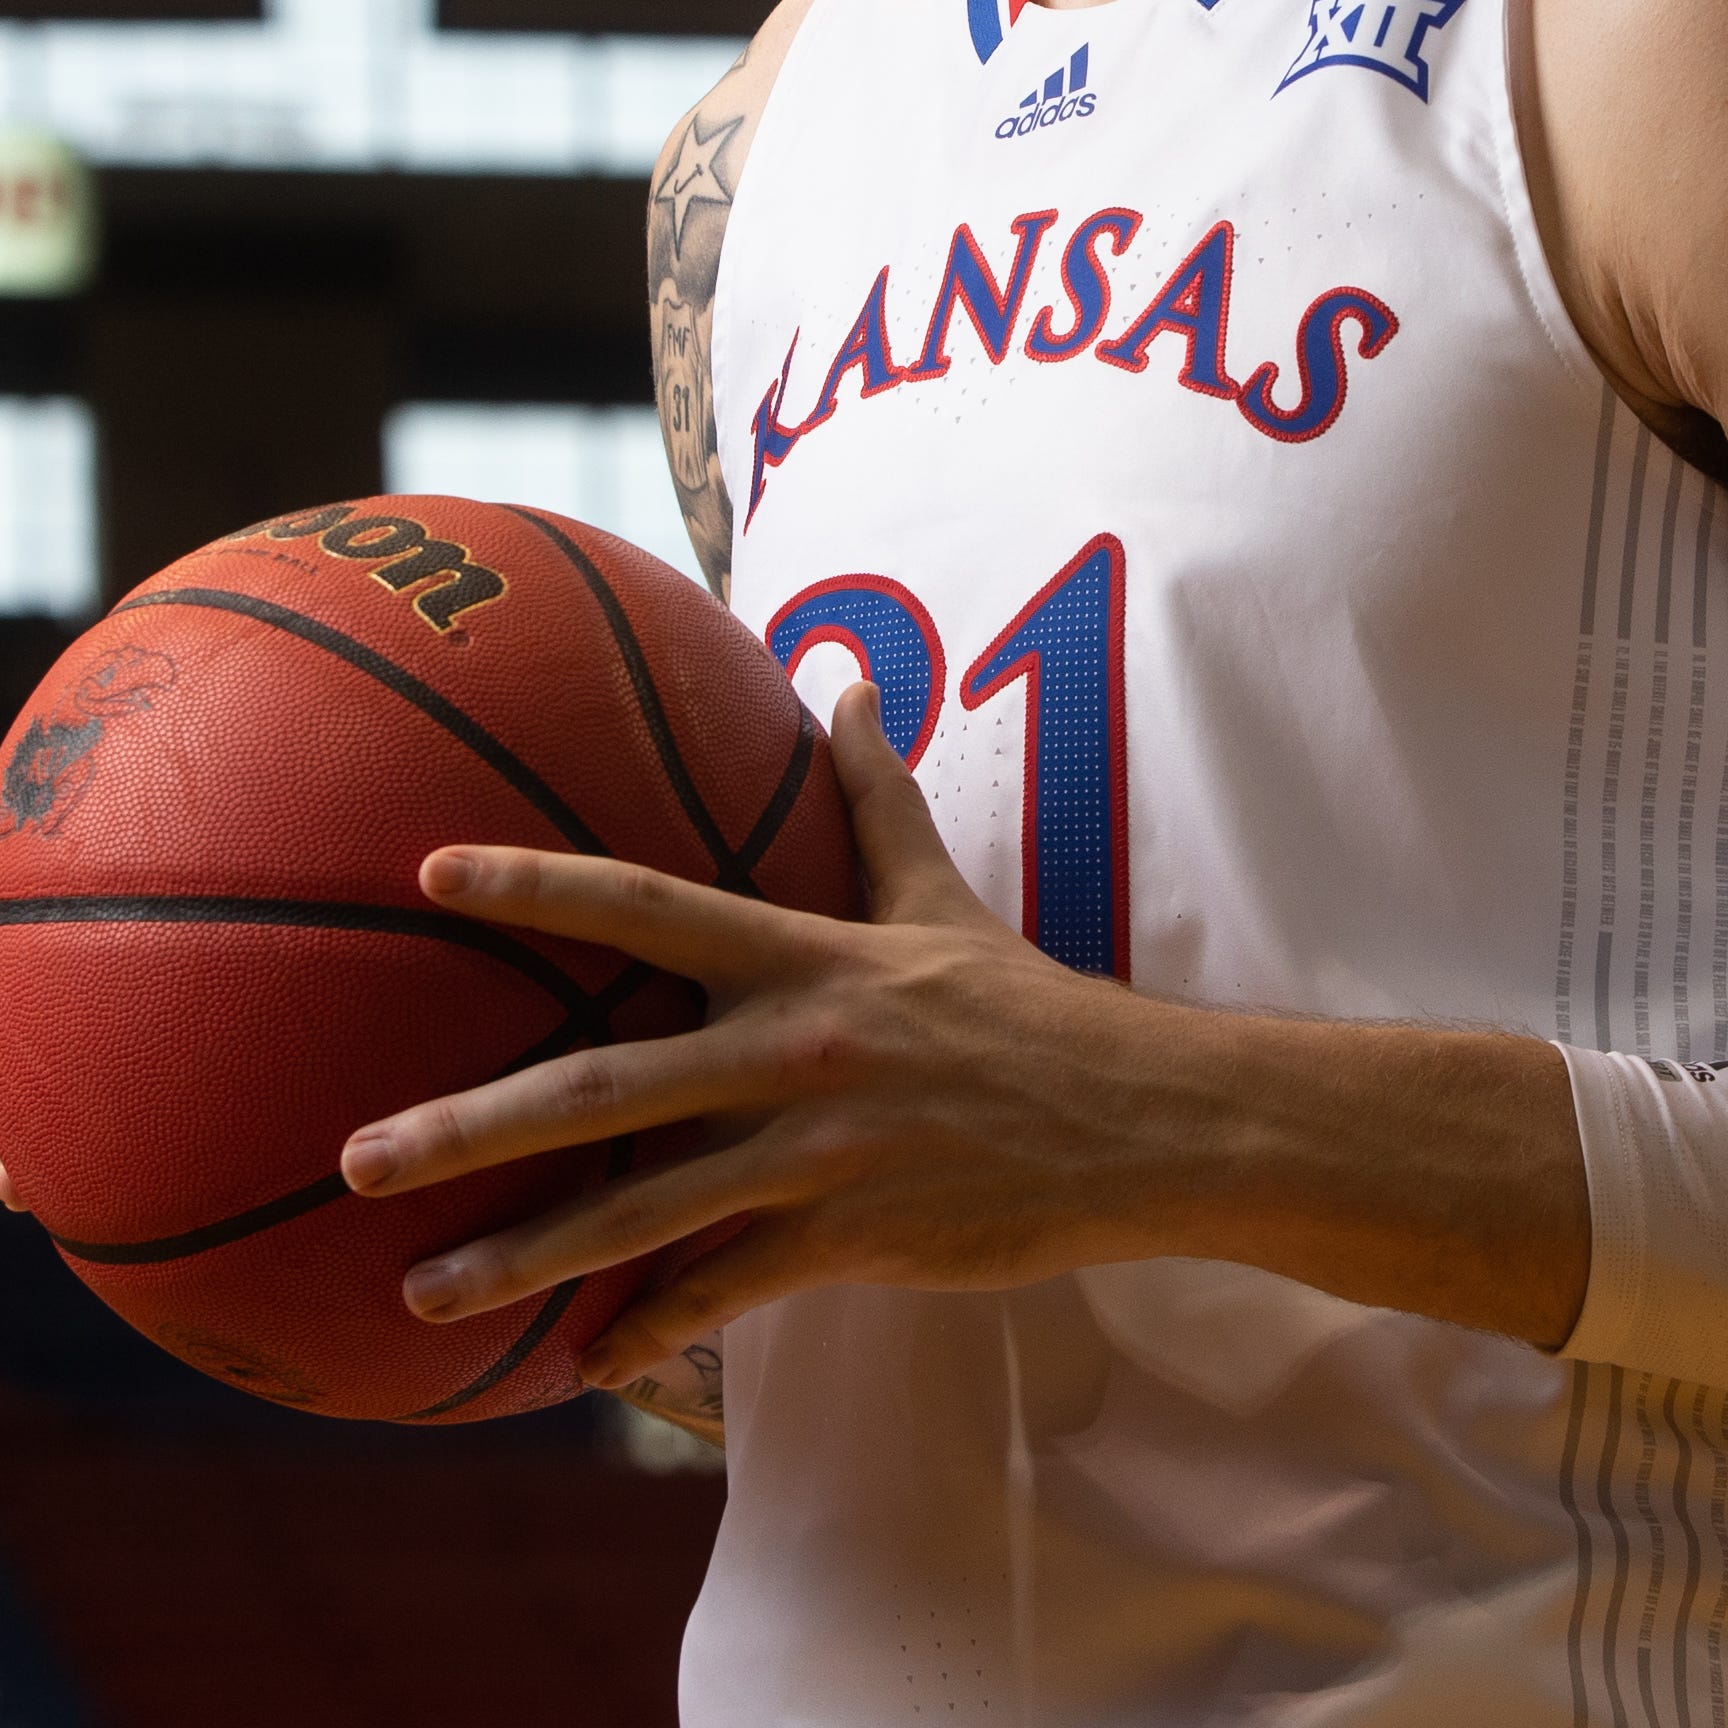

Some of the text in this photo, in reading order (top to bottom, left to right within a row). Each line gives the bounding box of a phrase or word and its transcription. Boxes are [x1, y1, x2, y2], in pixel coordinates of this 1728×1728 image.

[995, 93, 1097, 139] adidas
[743, 207, 1401, 537] KANSAS
[224, 503, 508, 635] son
